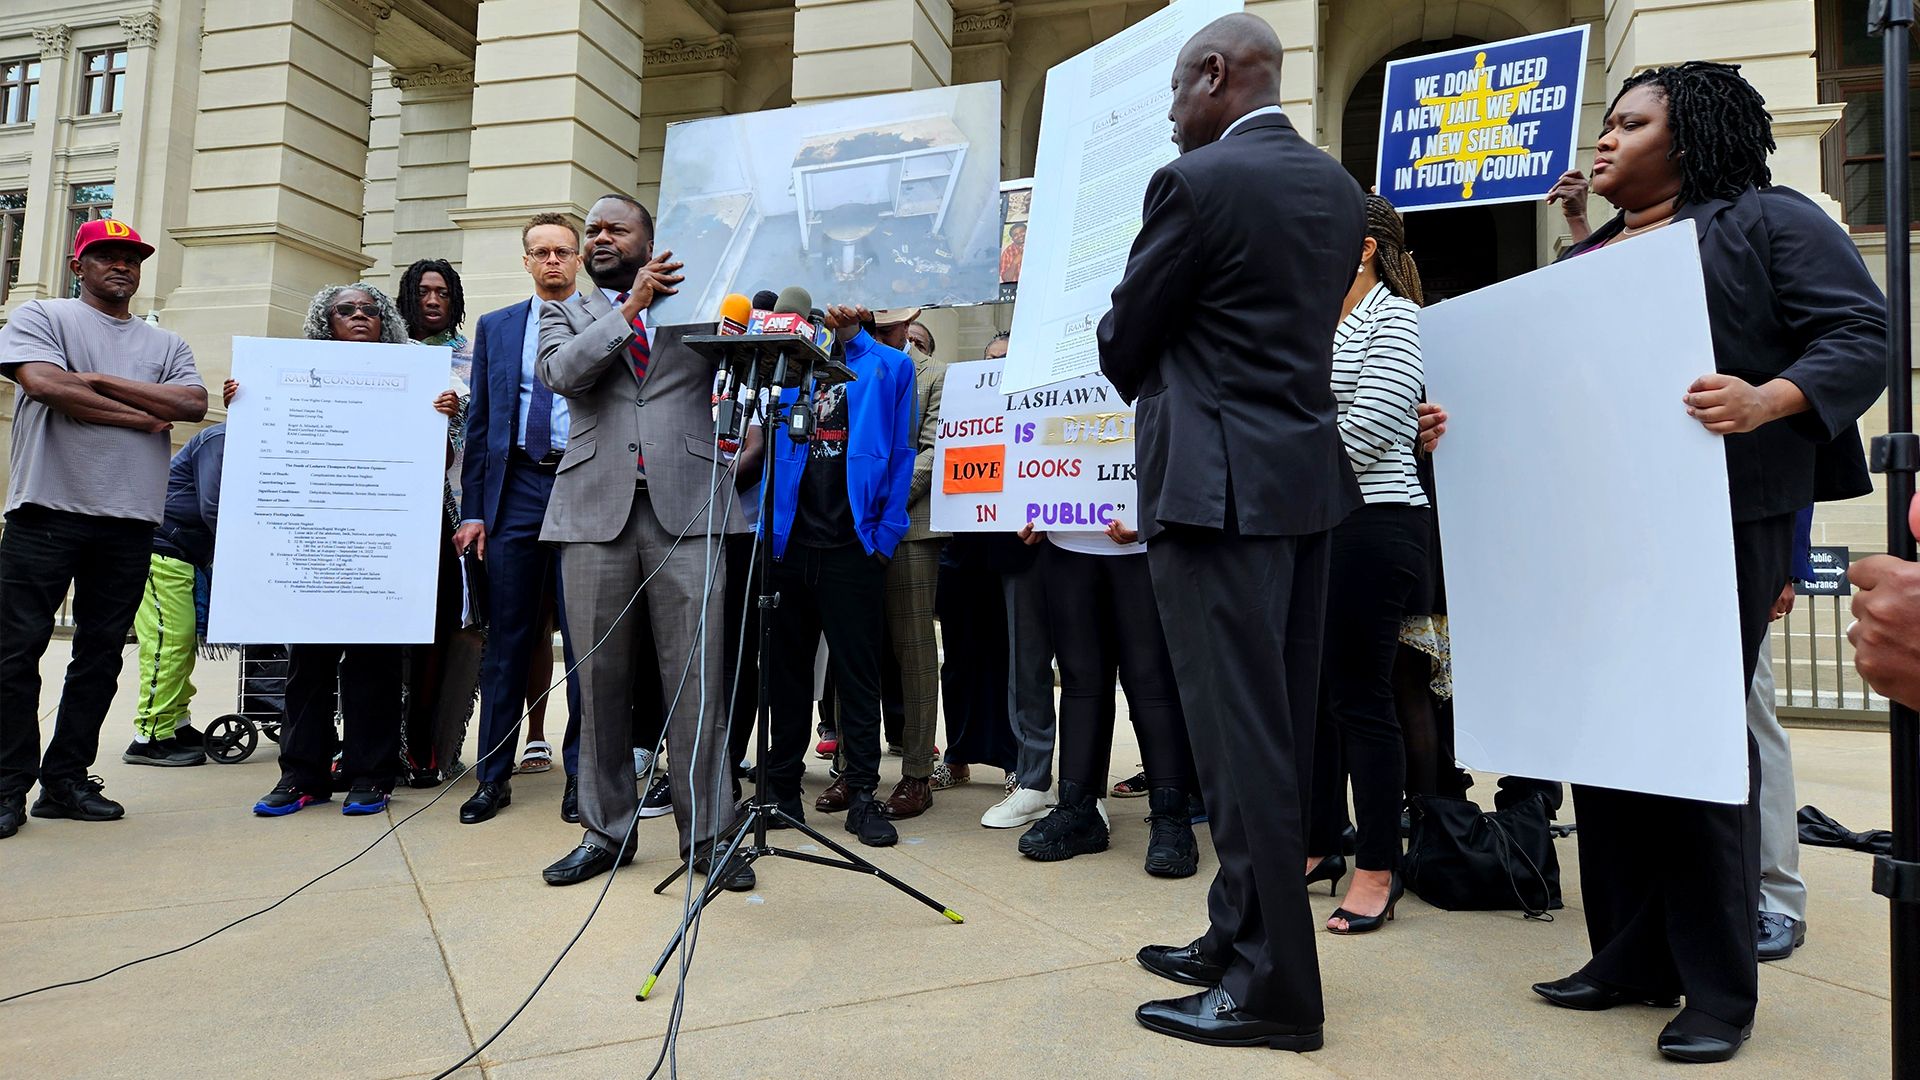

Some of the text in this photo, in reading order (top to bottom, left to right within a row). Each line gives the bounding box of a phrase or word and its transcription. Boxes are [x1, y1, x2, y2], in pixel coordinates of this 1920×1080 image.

[1415, 56, 1548, 100] WE DON'T NEED
[1391, 86, 1566, 133] A NEW JAIL WE NEED
[1409, 121, 1540, 160] A NEW SHERIFF
[1394, 151, 1553, 190] IN FULTON COUNTY
[323, 375, 400, 387] CONSULTING
[975, 371, 1002, 390] JU
[1006, 385, 1110, 411] LASHAWN
[1014, 422, 1036, 444] IS
[953, 458, 1137, 481] LOVE LOOKS LIK
[976, 504, 997, 523] IN
